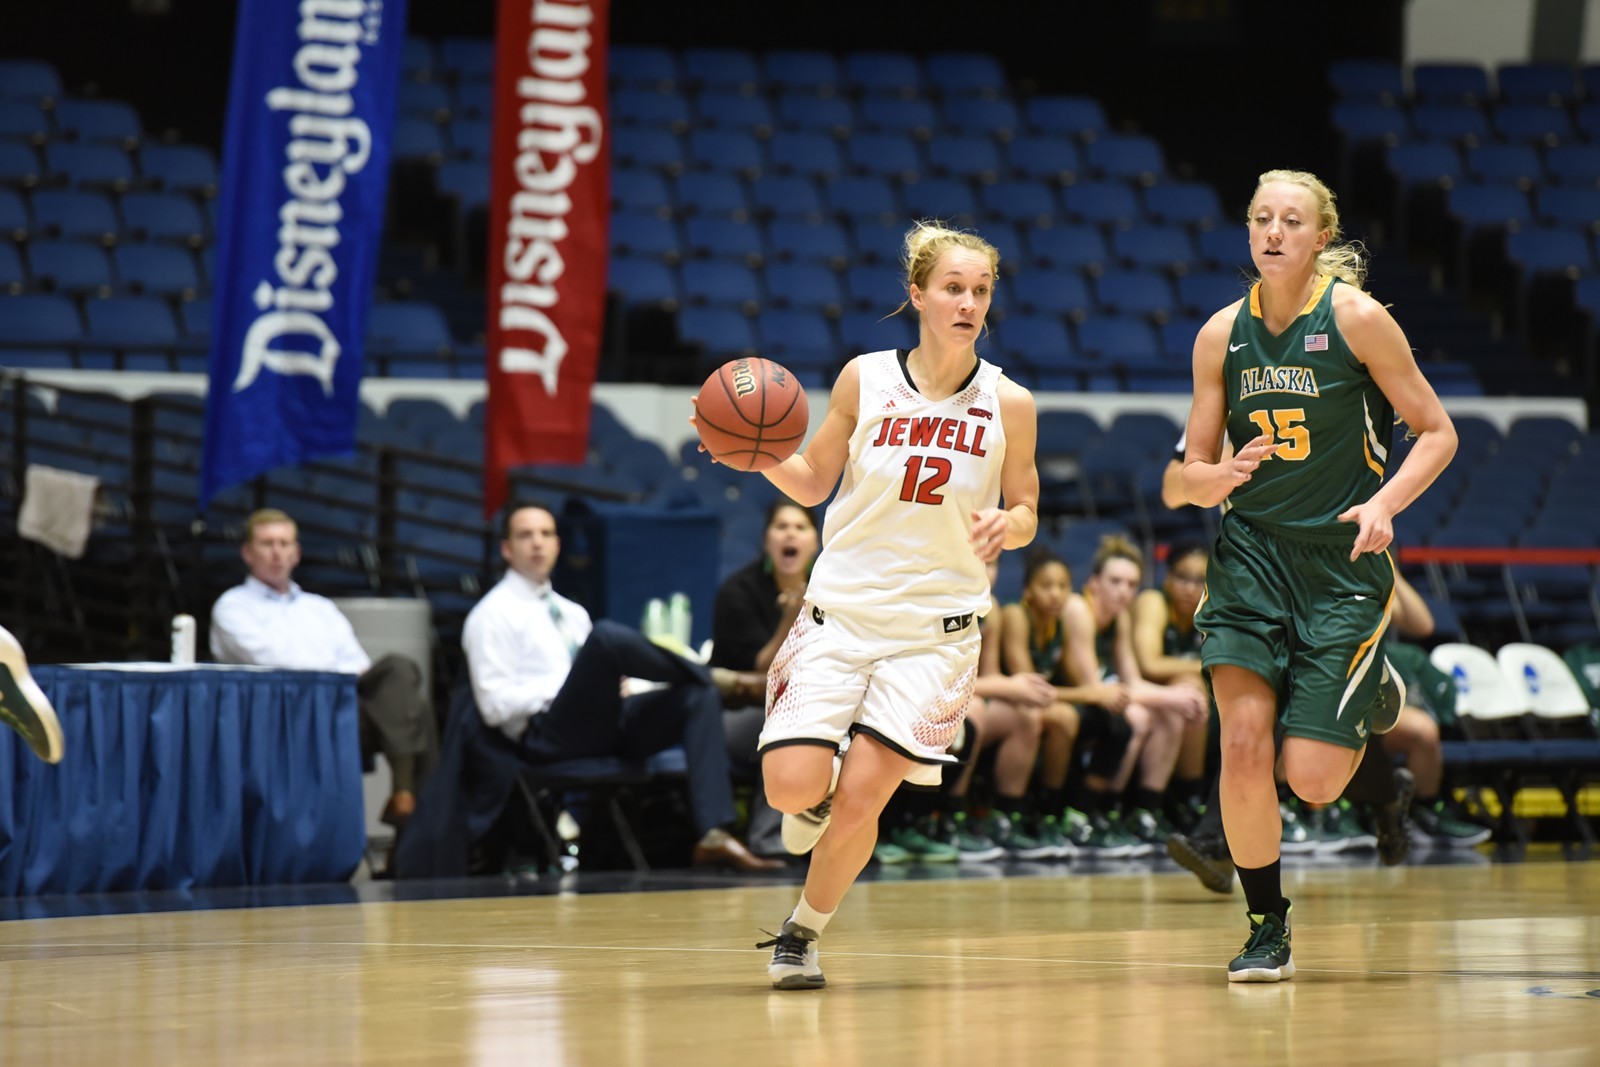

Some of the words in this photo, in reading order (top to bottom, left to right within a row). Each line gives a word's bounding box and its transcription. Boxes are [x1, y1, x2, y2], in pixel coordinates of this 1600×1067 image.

[1239, 365, 1320, 401] ALASKA
[873, 416, 987, 458] JEWELL
[1249, 408, 1311, 461] 15
[899, 455, 953, 506] 12
